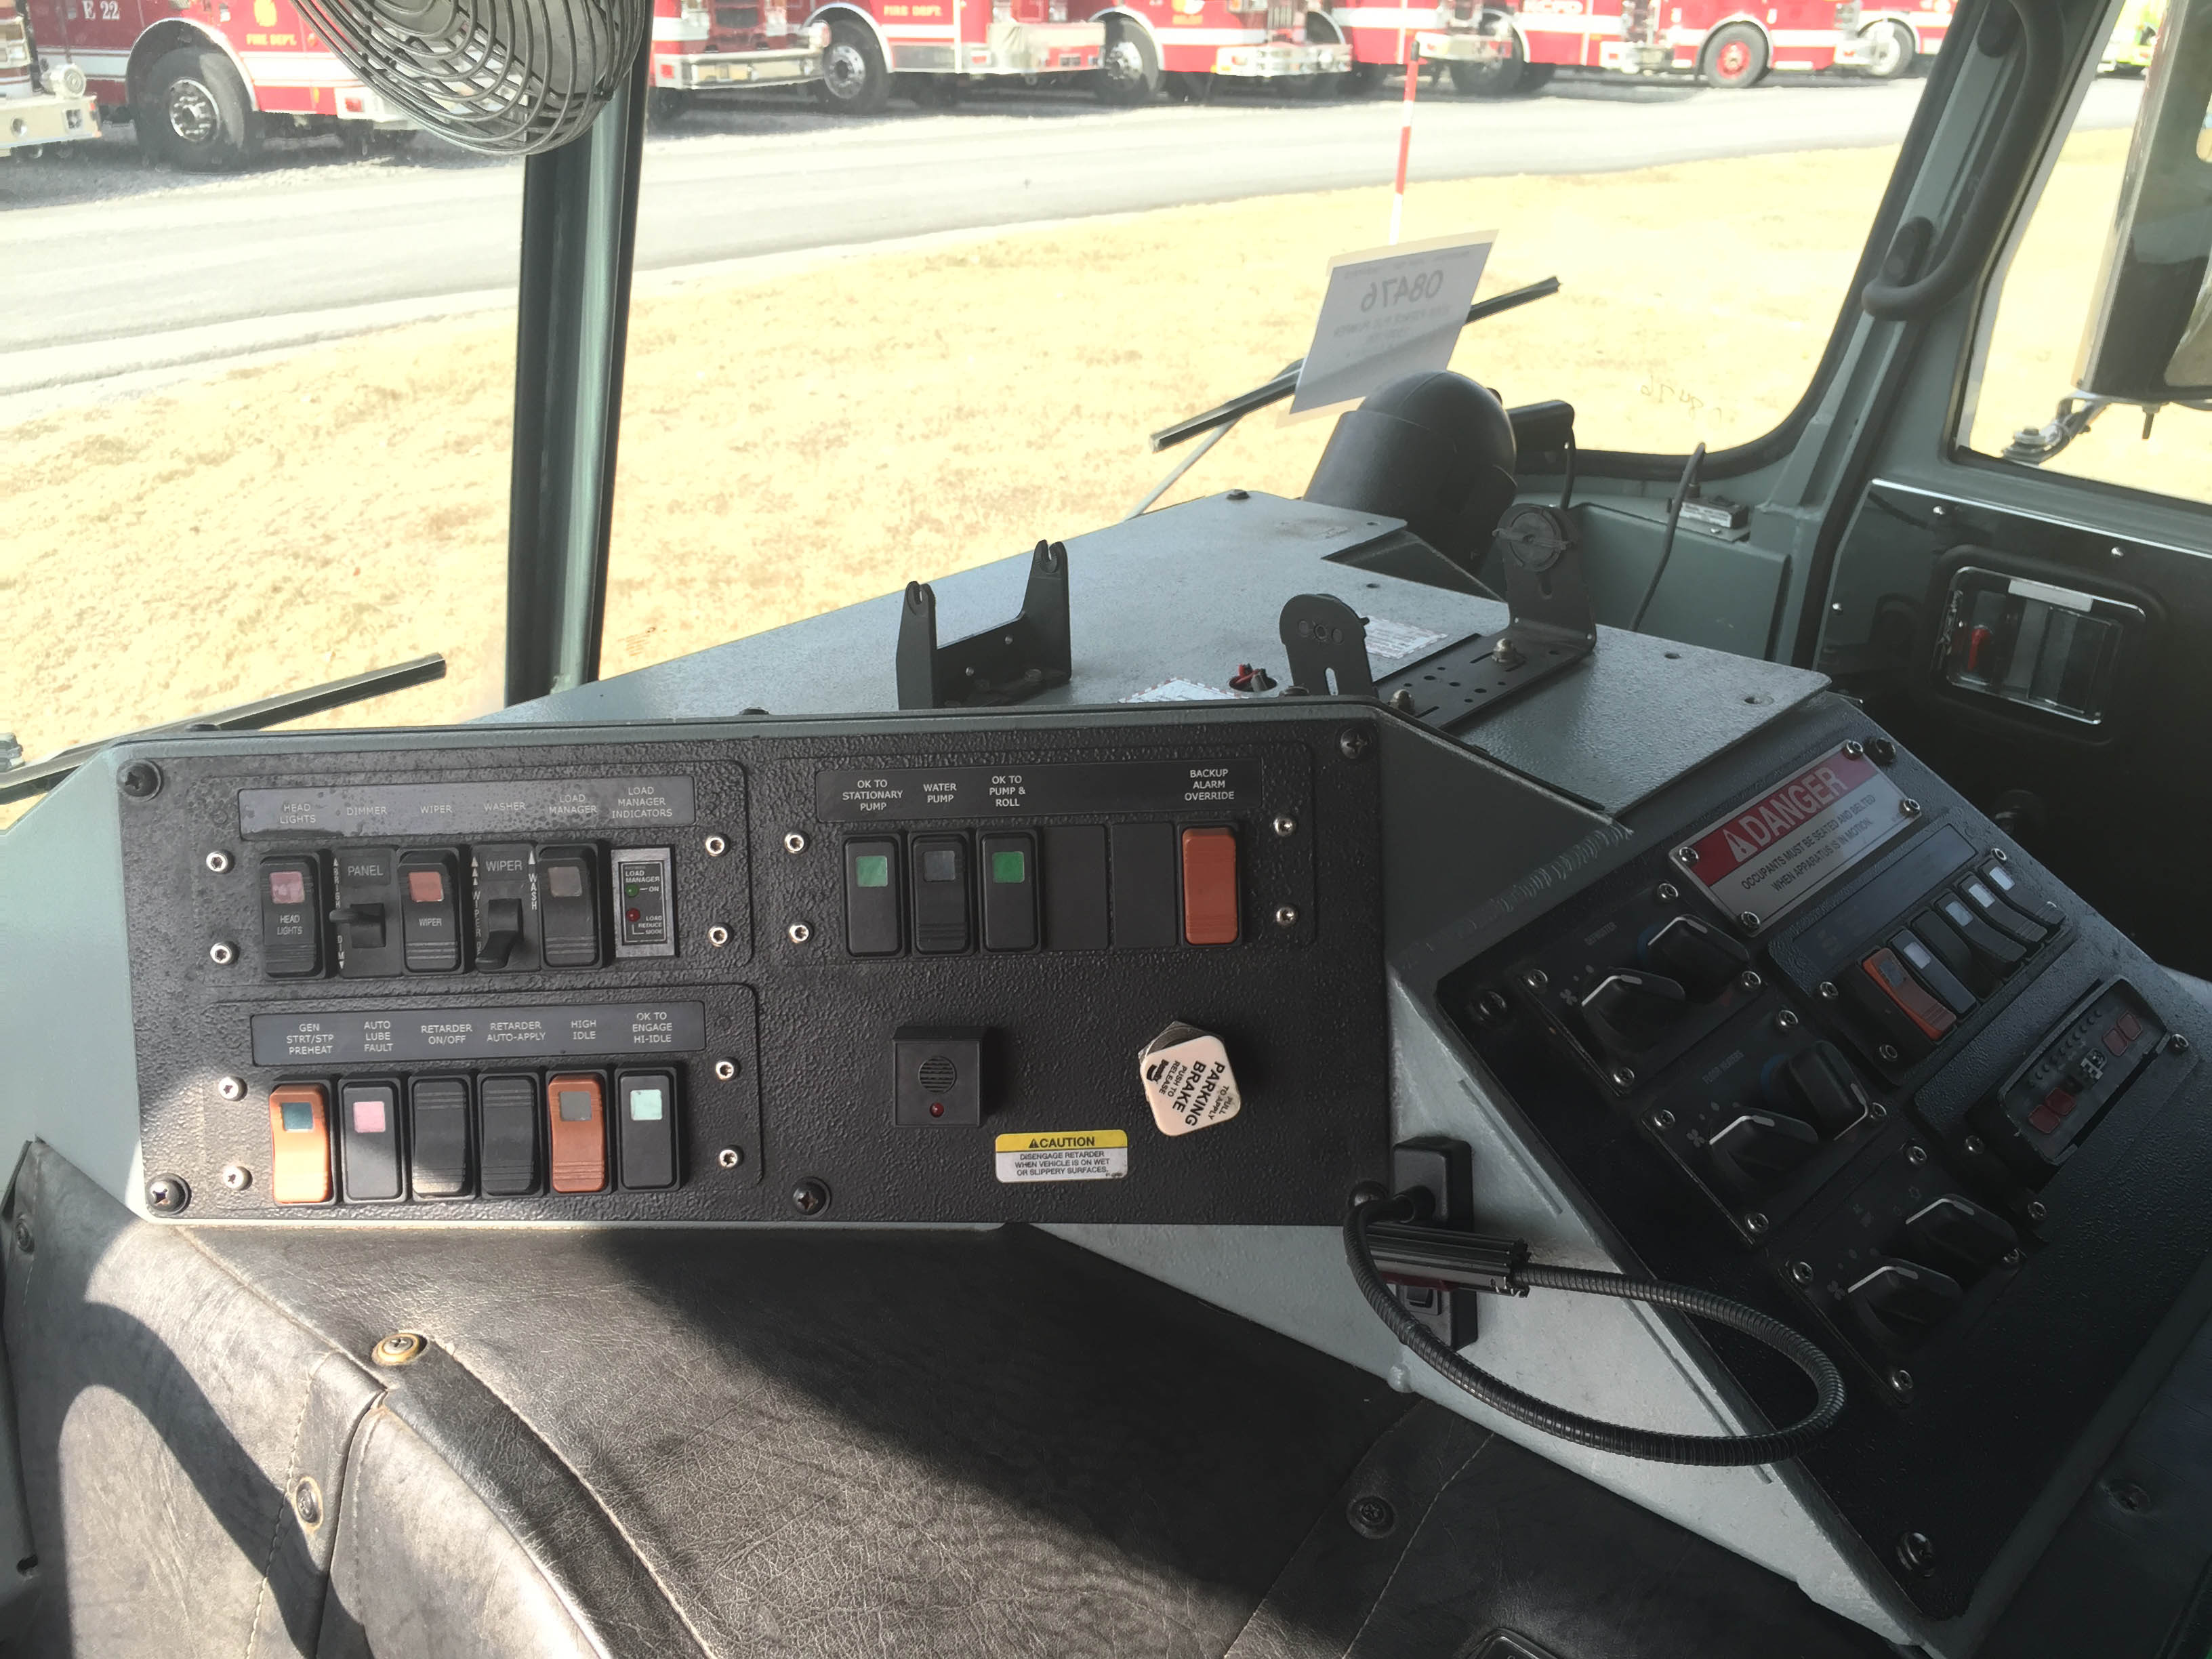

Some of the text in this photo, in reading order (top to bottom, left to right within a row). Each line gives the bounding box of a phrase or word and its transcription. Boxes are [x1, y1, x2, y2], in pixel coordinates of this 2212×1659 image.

[83, 1, 120, 20] E 22
[1190, 769, 1229, 778] BACKUP
[857, 779, 888, 788] OK TO
[991, 775, 1022, 784] OK TO
[924, 783, 957, 792] WATER
[1193, 781, 1225, 790] ALARM
[628, 787, 655, 795] LOAD
[842, 790, 903, 800] STATIONARY
[989, 787, 1025, 796] PUMP &
[559, 794, 586, 802] LOAD
[927, 795, 954, 803] PUMP
[1185, 792, 1235, 801] OVERRIDE
[484, 802, 526, 811] WASHER
[618, 798, 665, 806] MANAGER
[860, 802, 887, 811] PUMP
[996, 798, 1020, 807] ROLL
[1739, 766, 1848, 846] DANGER
[283, 804, 310, 812] HEAD
[346, 806, 387, 815] DIMMER
[420, 805, 453, 814] WIPER
[549, 805, 597, 814] MANAGER
[612, 808, 673, 819] INDICATORS
[280, 815, 316, 824] LIGHTS
[1741, 794, 1876, 890] OCCUPANTS MUST BE SEATED AND BELTED
[486, 860, 523, 872] WIPER
[1771, 872, 1796, 892] WHEN
[1793, 844, 1834, 877] APPARATUS
[1831, 840, 1841, 849] IS
[1838, 835, 1849, 844] IN
[348, 865, 384, 876] PANEL
[529, 873, 537, 910] WASH
[472, 890, 481, 938] WIPER
[280, 915, 300, 923] HEAD
[419, 918, 442, 926] WIPER
[277, 926, 303, 935] LIGHTS
[636, 1012, 667, 1021] OK TO
[299, 1023, 320, 1032] GEN
[364, 1021, 391, 1029] AUTO
[421, 1024, 472, 1033] RETARDER
[490, 1021, 541, 1030] RETARDER
[571, 1020, 596, 1029] HIGH
[632, 1023, 672, 1032] ENGAGE
[286, 1034, 334, 1044] STRT/STP
[365, 1032, 390, 1041] LUBE
[487, 1032, 546, 1042] AUTO-APPLY
[573, 1031, 596, 1040] IDLE
[634, 1034, 672, 1044] HI-IDLE
[428, 1036, 466, 1045] ON/OFF
[289, 1046, 333, 1054] PREHEAT
[364, 1043, 393, 1052] FAULT
[1159, 1061, 1181, 1095] RELEASE
[1167, 1065, 1187, 1097] PUSH TO
[1172, 1061, 1206, 1113] BRAKE
[1185, 1061, 1225, 1126] PARKING
[1208, 1085, 1229, 1120] TO APPLY
[1218, 1096, 1233, 1114] PULL
[1040, 1136, 1095, 1148] CAUTION
[1020, 1151, 1105, 1160] DISENGAGE RETARDER
[1038, 1160, 1071, 1168] VEHICLE
